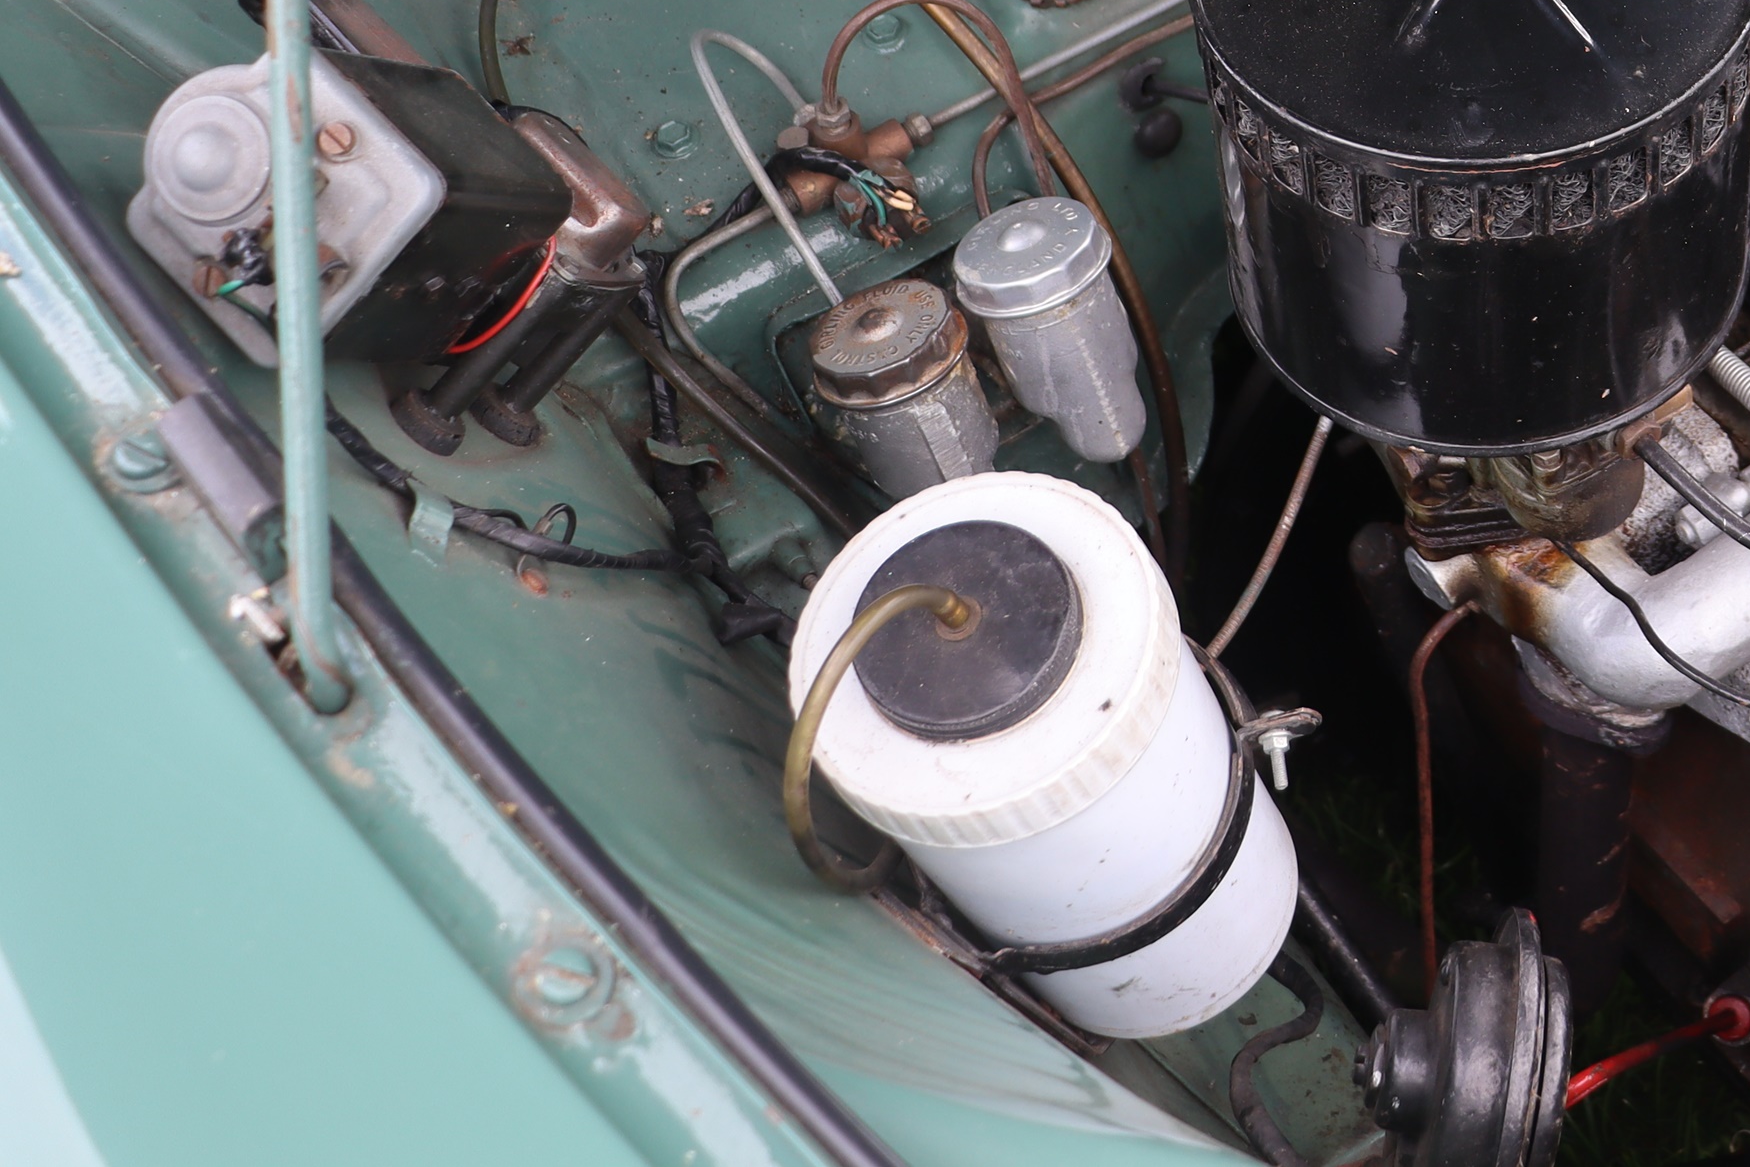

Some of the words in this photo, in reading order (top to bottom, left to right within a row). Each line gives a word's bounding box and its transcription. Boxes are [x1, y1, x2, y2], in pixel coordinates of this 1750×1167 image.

[863, 284, 911, 302] FLUID
[914, 289, 937, 310] USE
[819, 303, 855, 352] GIRLING
[905, 313, 934, 344] ONLY
